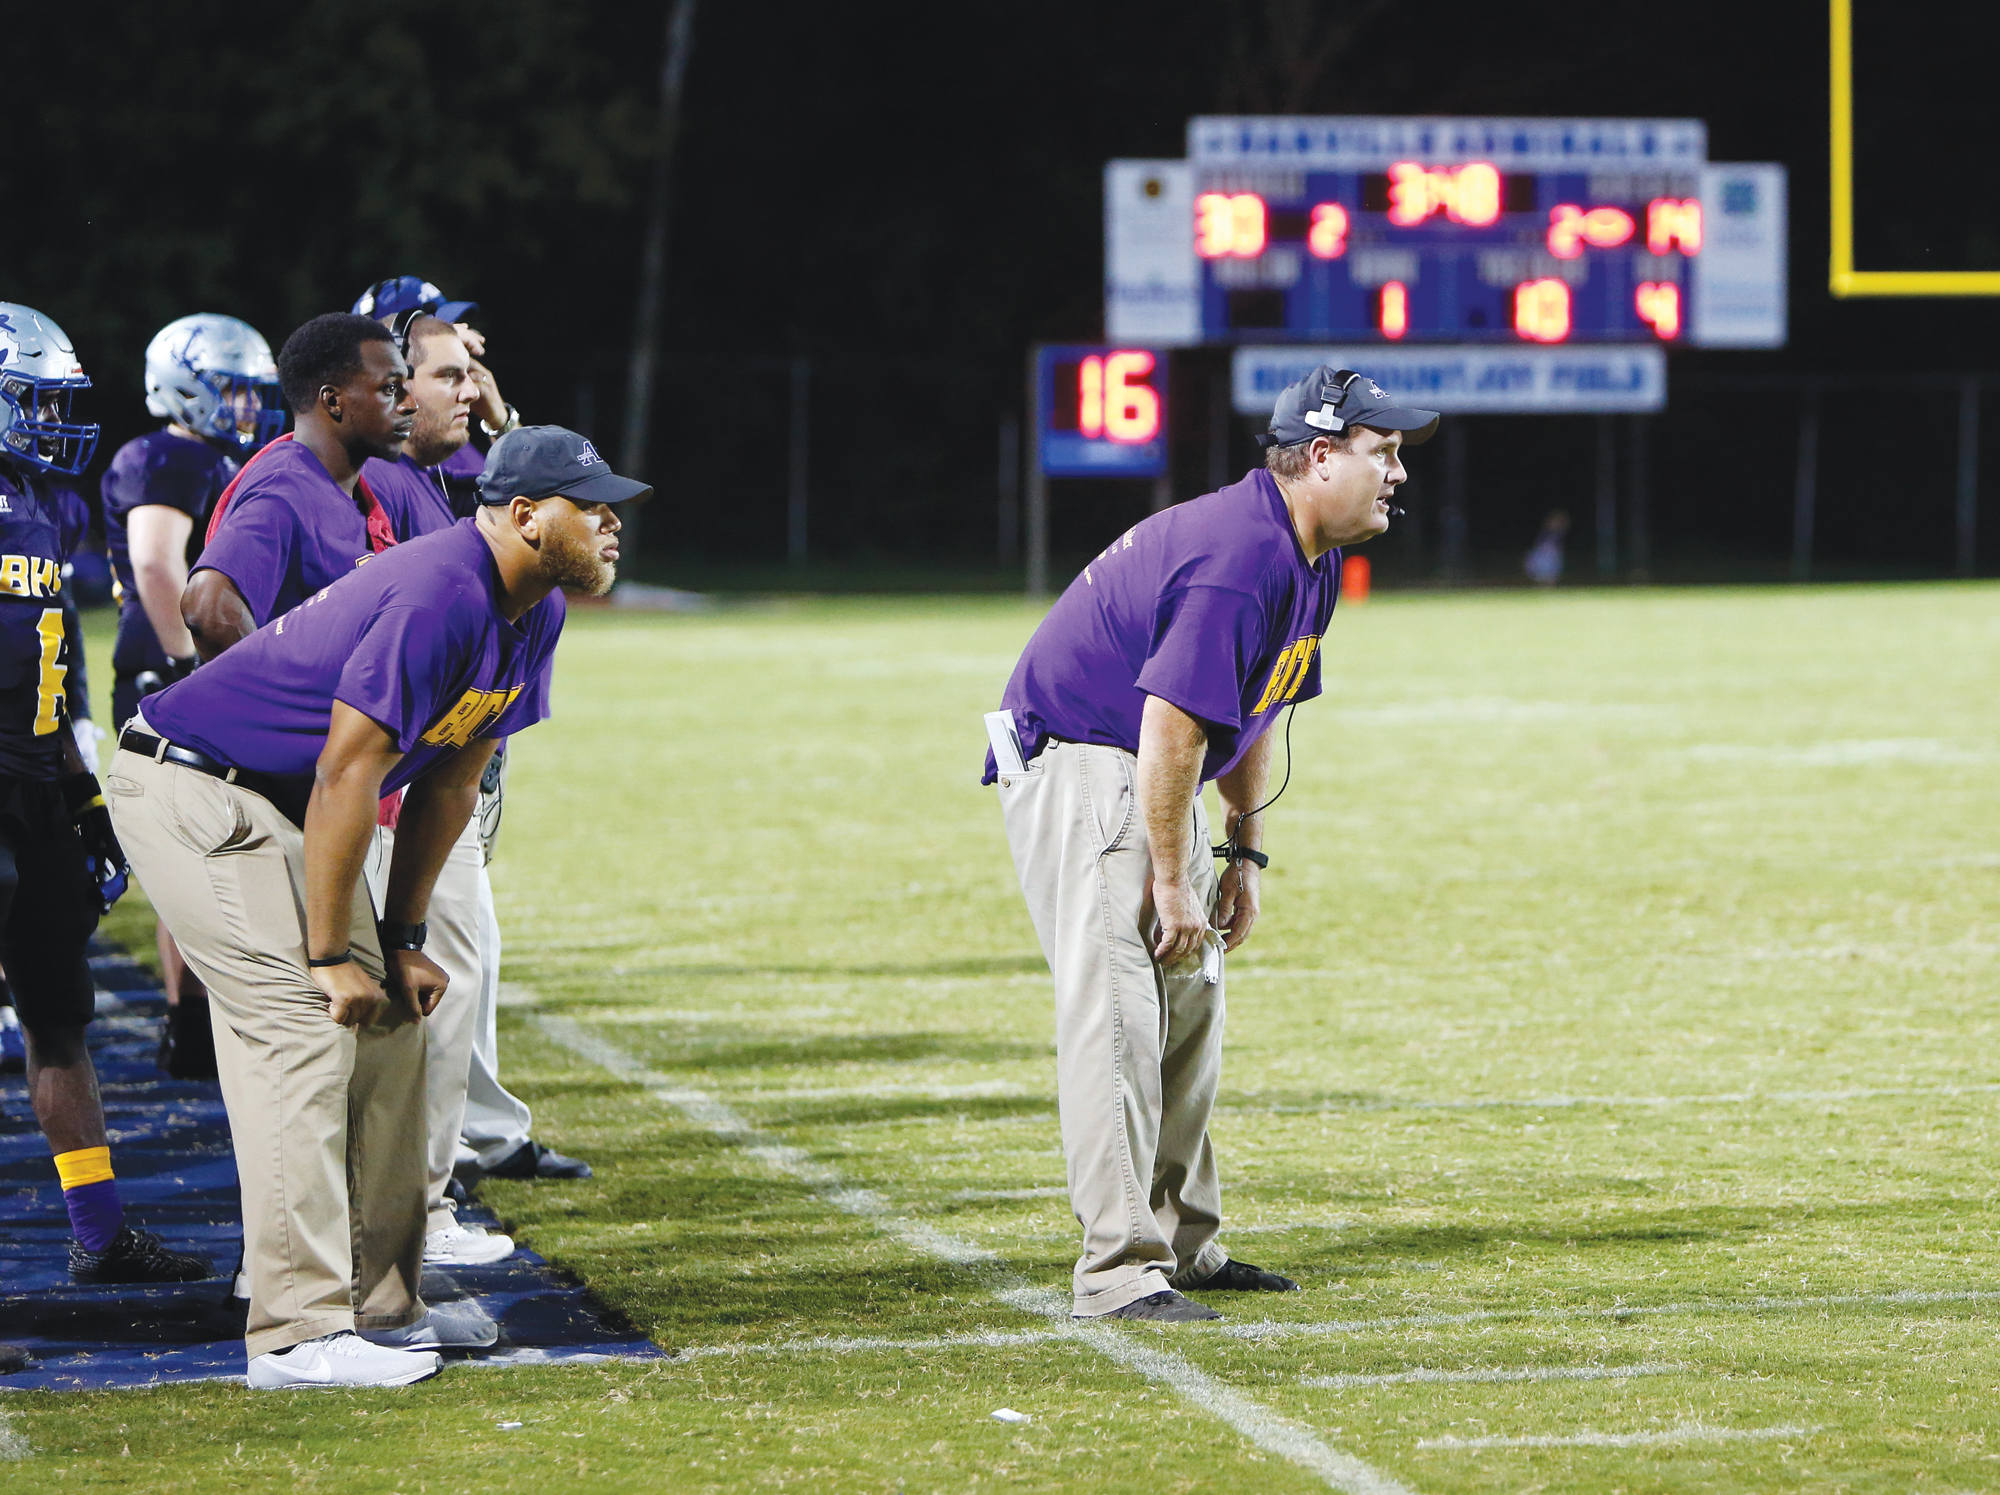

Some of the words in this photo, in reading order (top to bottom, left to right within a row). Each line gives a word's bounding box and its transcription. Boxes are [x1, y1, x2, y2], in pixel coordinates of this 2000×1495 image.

[1309, 202, 1349, 258] 2
[1548, 203, 1585, 260] 2
[1380, 280, 1408, 340] 1
[1636, 281, 1680, 340] 4
[1079, 350, 1160, 444] 16
